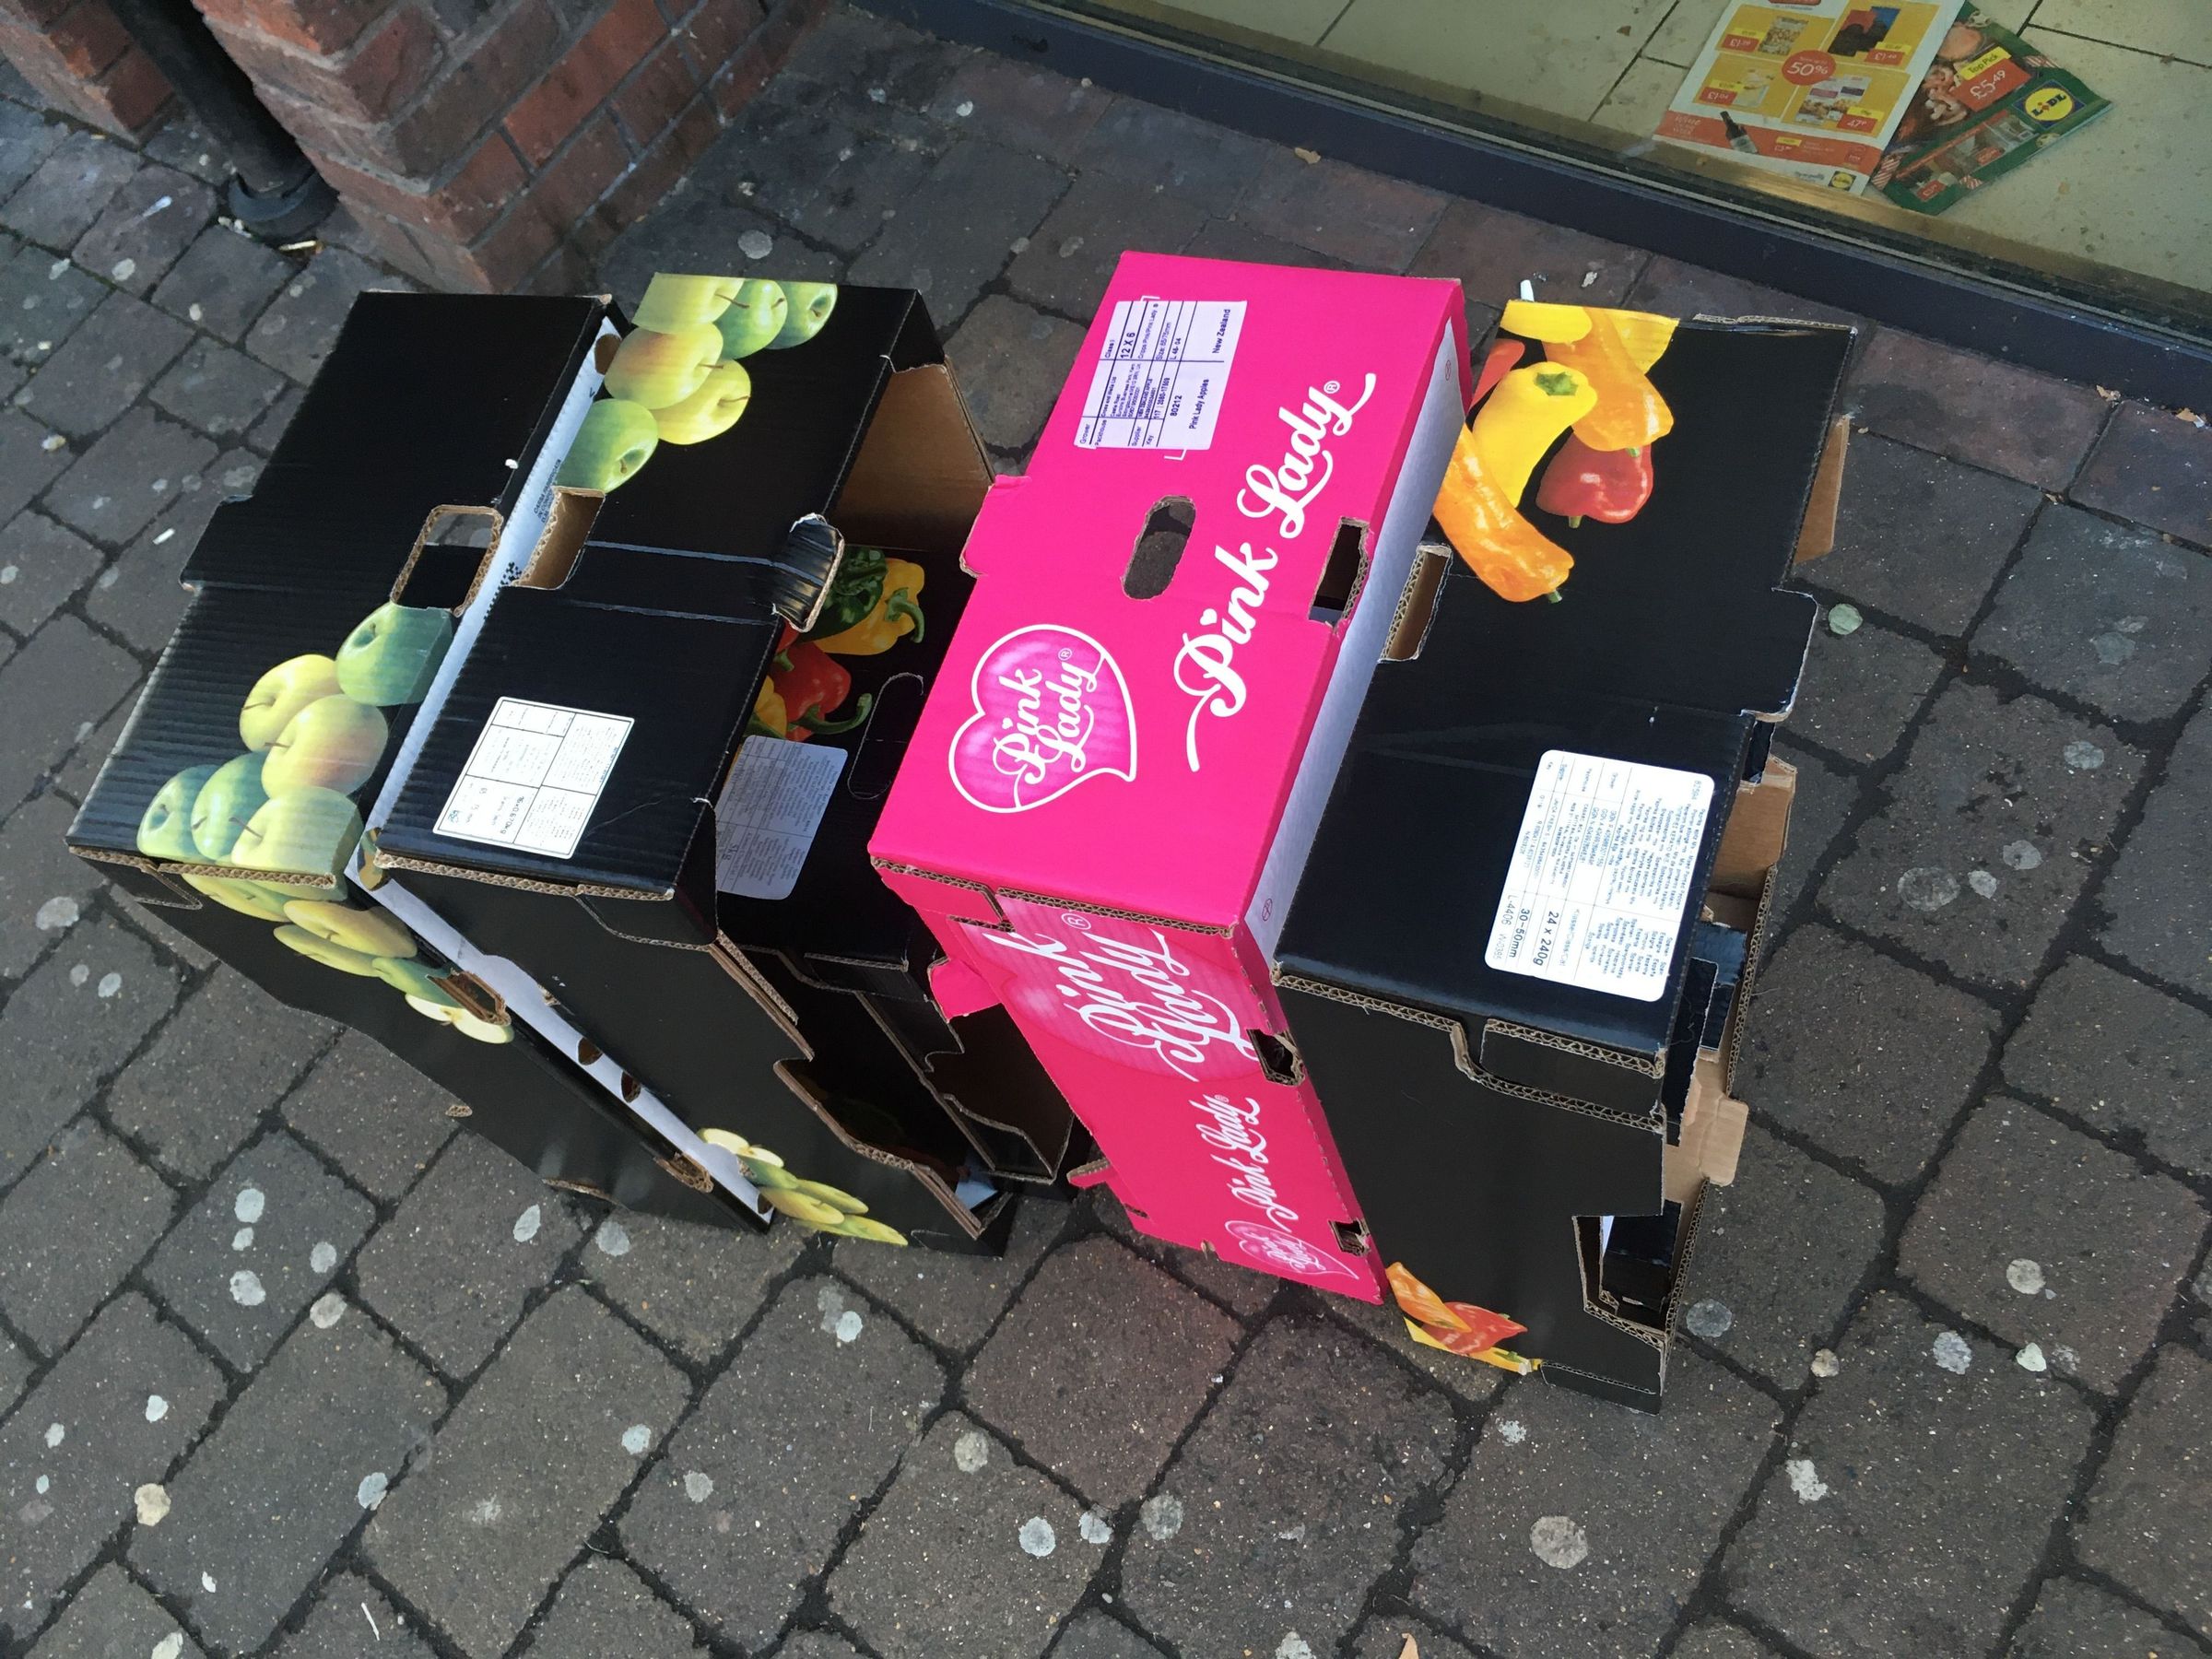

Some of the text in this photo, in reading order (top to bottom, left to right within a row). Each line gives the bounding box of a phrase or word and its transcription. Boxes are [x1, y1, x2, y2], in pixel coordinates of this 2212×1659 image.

[1787, 61, 1828, 76] 50%
[1968, 53, 1999, 75] Top Pick
[1212, 309, 1231, 353] New Zealand
[1104, 343, 1113, 357] Class
[1119, 348, 1131, 358] 12
[1169, 395, 1182, 416] 80212
[1188, 379, 1210, 429] Pink Lady Apples
[1145, 435, 1154, 444] Key
[1173, 542, 1277, 771] Pink
[992, 667, 1045, 809] Pink
[1546, 911, 1559, 924] 24
[1508, 908, 1530, 958] 30-50mm
[1532, 937, 1552, 966] 240g
[982, 931, 1205, 1081] Pink
[1210, 1154, 1299, 1232] Pink
